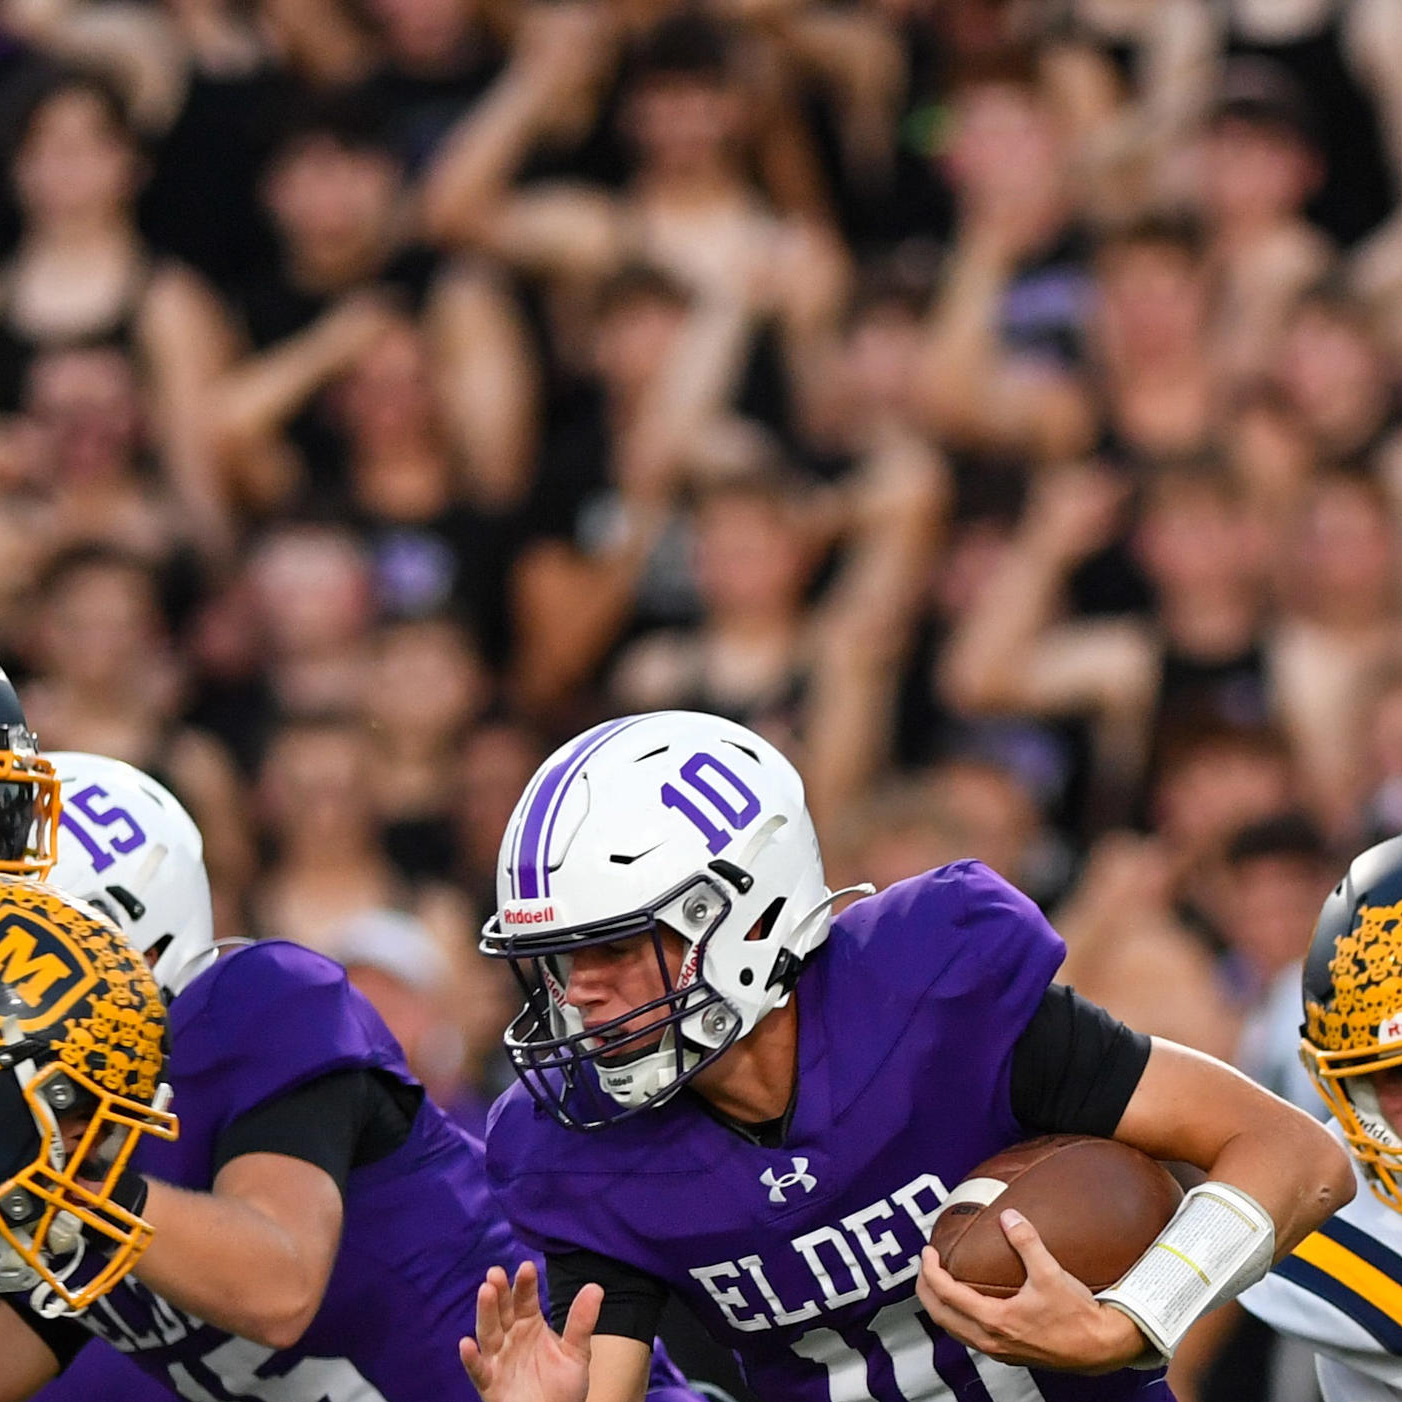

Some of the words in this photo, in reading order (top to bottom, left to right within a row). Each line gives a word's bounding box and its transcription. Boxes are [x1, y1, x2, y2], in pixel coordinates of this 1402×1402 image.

[58, 784, 147, 875] 15
[660, 751, 762, 857] 10
[503, 906, 555, 925] Riddell
[688, 1173, 953, 1332] ELDER
